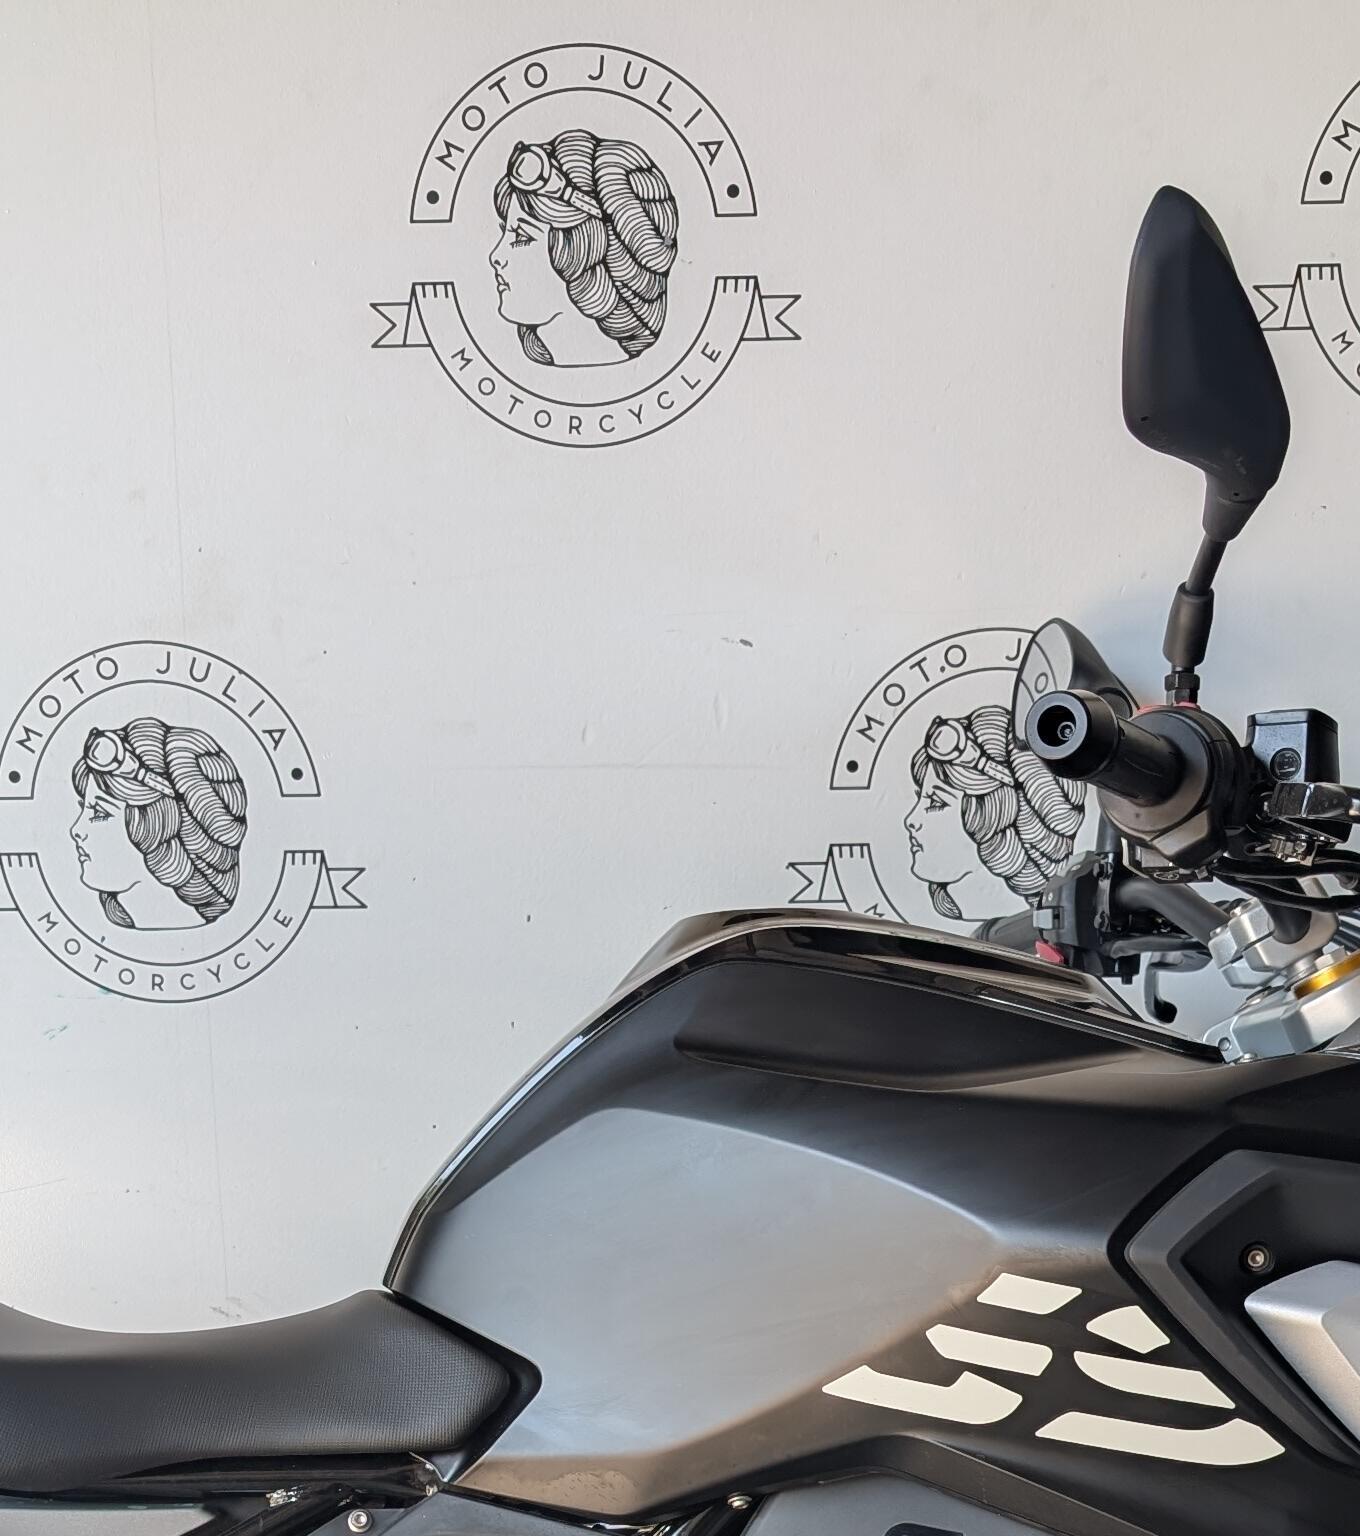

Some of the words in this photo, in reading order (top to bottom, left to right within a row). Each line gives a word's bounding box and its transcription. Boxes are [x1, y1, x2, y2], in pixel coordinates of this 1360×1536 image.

[435, 62, 548, 171] MOTO
[587, 55, 723, 165] JULIA
[451, 342, 721, 434] MOTORCYCLE
[16, 657, 118, 753] MOTO
[156, 651, 286, 751] JULIA
[856, 644, 967, 743] MOTO
[38, 909, 292, 991] MOTORCYCLE
